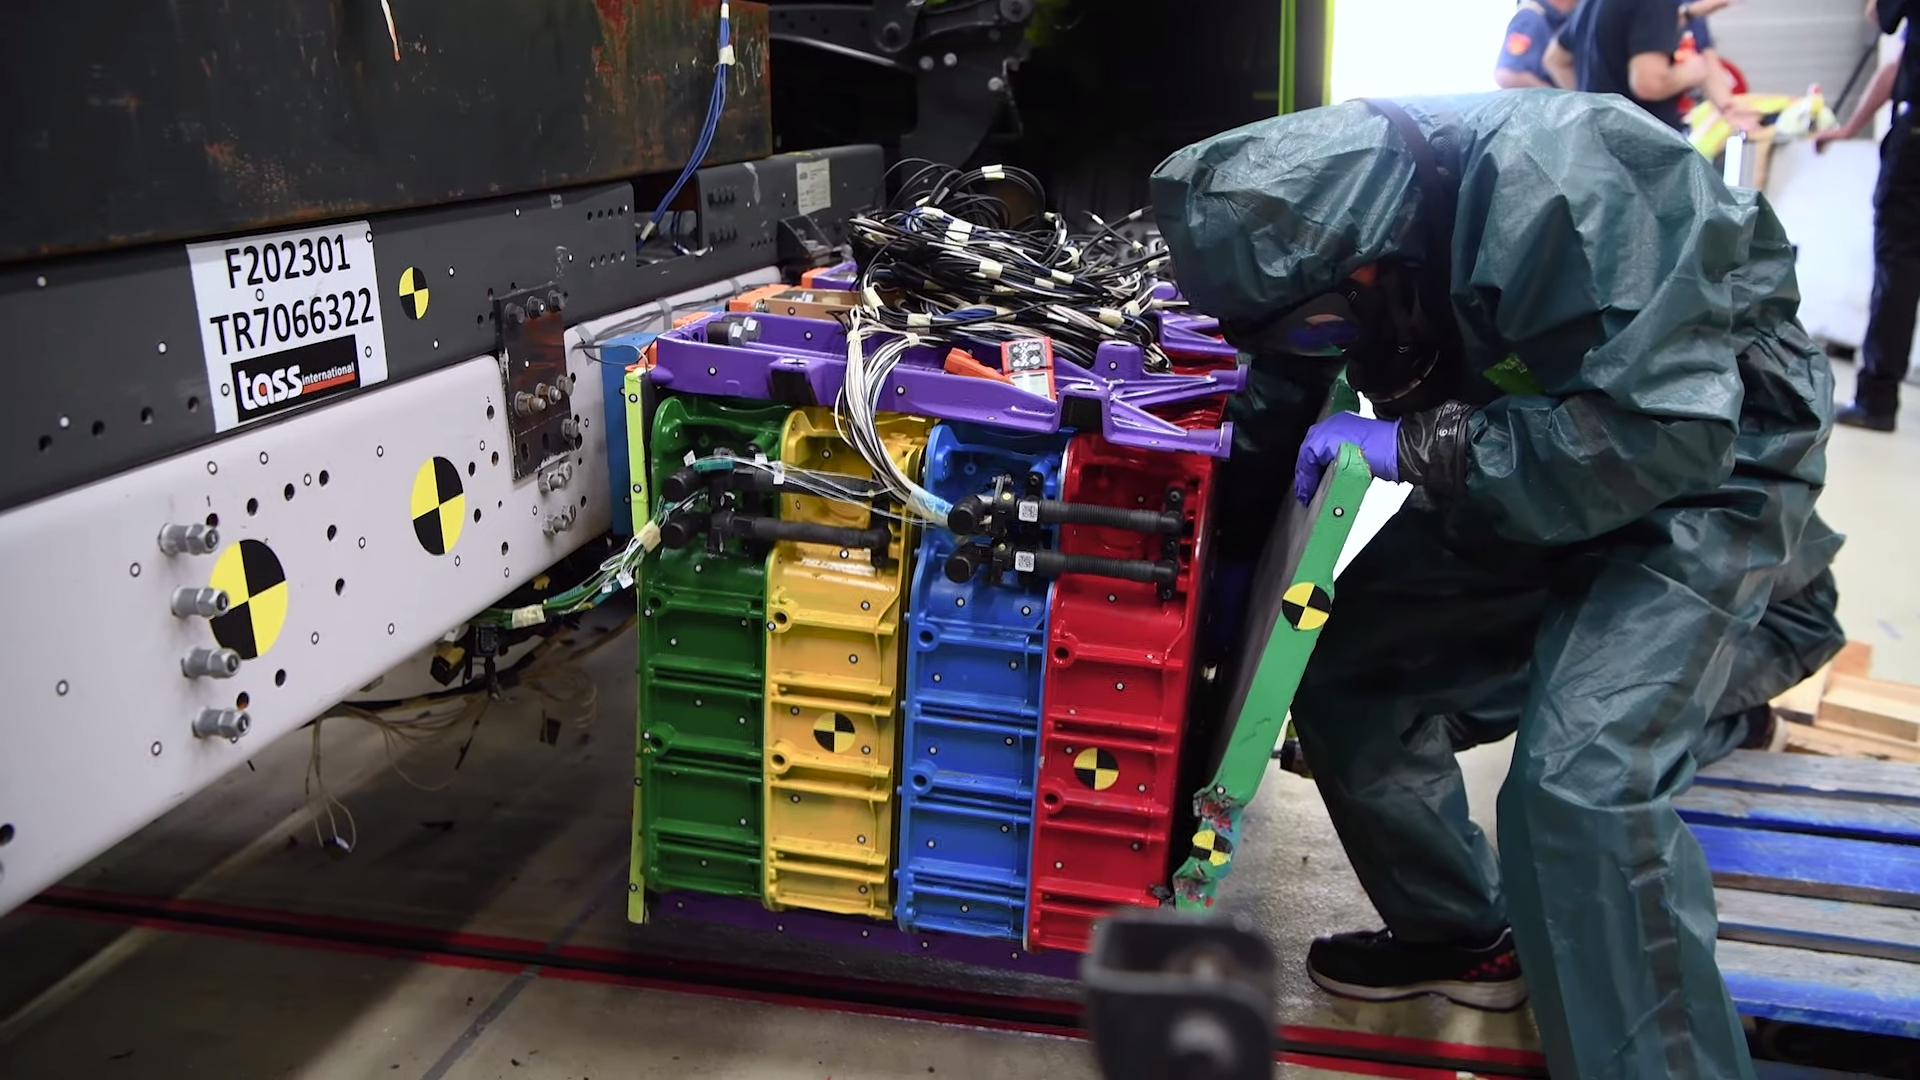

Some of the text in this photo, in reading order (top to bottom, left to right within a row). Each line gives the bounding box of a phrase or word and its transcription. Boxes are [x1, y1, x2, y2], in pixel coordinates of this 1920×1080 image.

[225, 234, 350, 288] F202301
[210, 287, 374, 355] TR7066322
[237, 362, 355, 411] tass international
